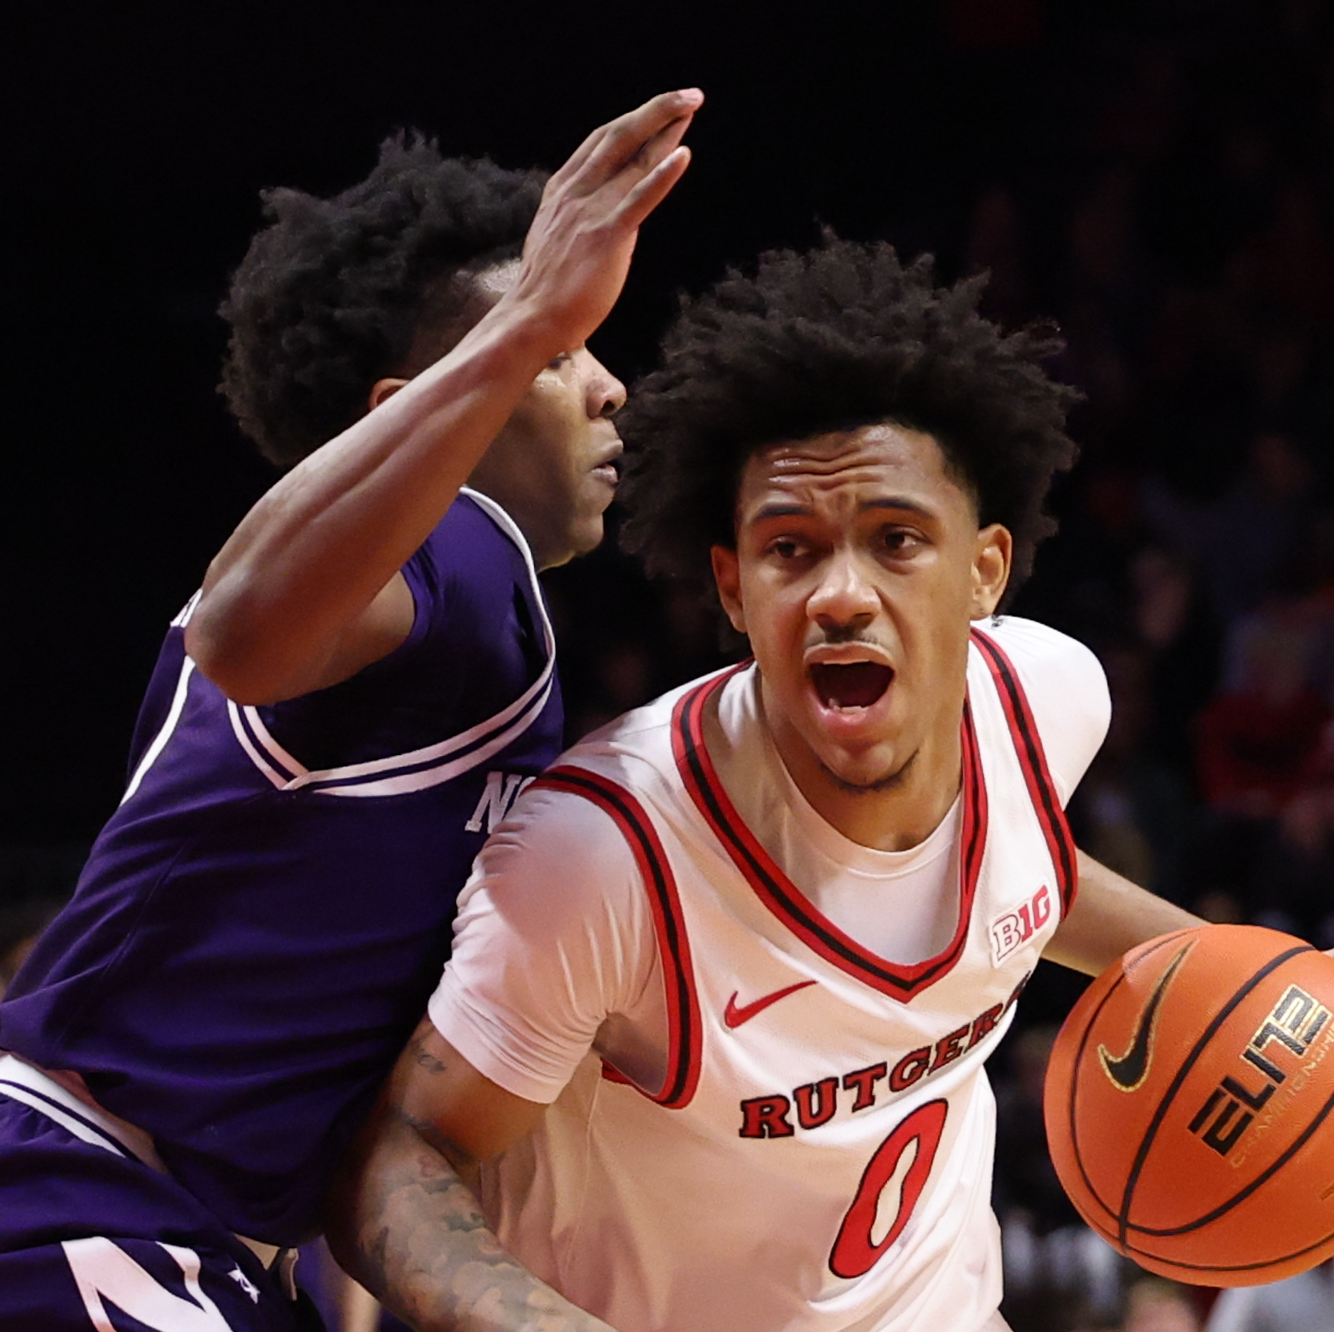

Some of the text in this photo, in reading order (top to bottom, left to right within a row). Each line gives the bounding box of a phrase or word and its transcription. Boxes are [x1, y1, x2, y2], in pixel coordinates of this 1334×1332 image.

[464, 771, 537, 834] N
[1187, 983, 1334, 1157] ELITE
[828, 1097, 950, 1280] 0
